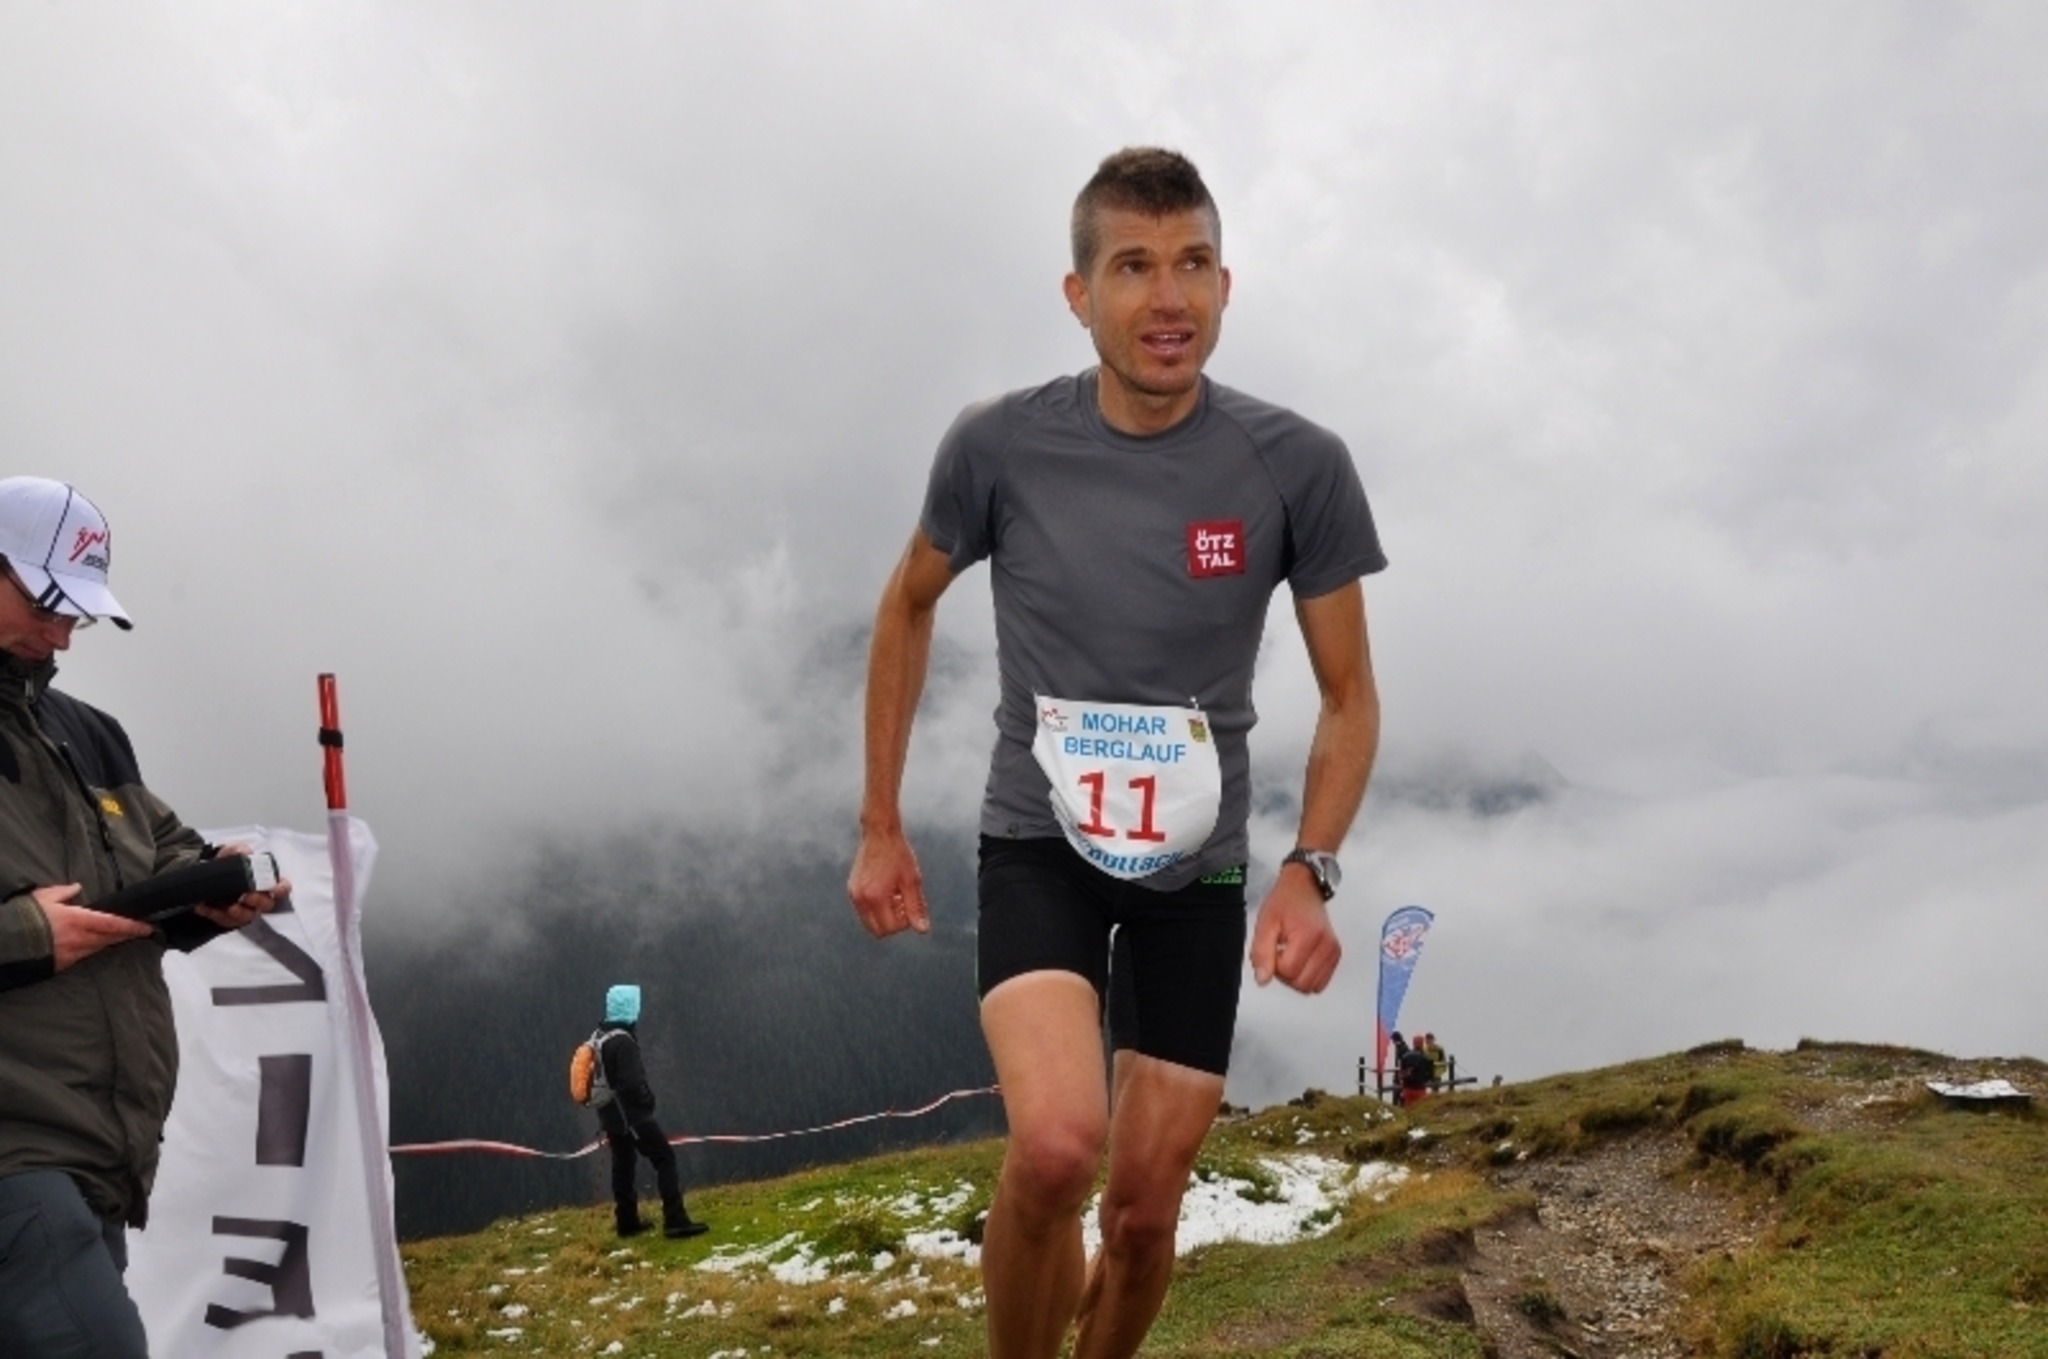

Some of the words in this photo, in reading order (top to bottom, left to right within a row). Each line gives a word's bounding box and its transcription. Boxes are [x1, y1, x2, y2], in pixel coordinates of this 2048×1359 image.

[1195, 529, 1235, 551] ÖTZ
[1197, 552, 1236, 569] TAL
[1082, 713, 1166, 735] MOHAR
[1064, 737, 1186, 763] BERGLAUF
[1077, 770, 1166, 842] 11
